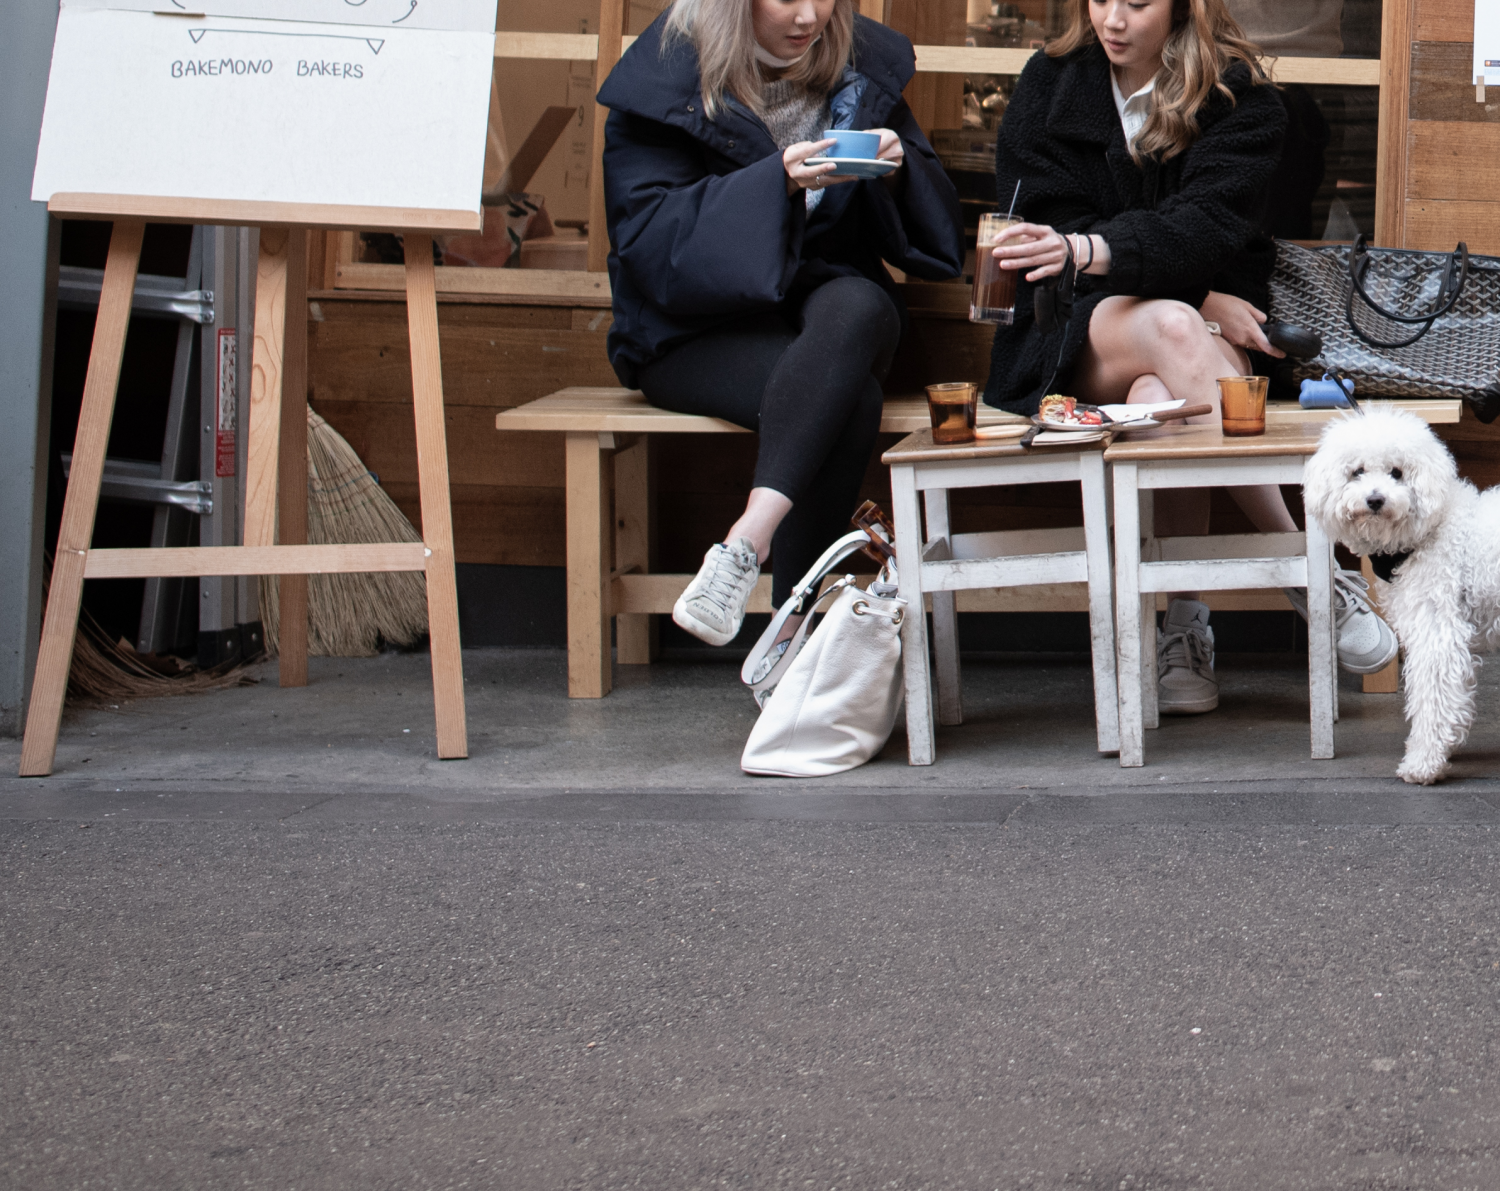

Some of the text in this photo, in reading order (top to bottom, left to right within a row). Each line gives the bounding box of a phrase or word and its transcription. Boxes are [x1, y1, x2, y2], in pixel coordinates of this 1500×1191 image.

[170, 58, 364, 79] BAKEMONO BAKERS
[692, 602, 724, 625] GOLDEN
